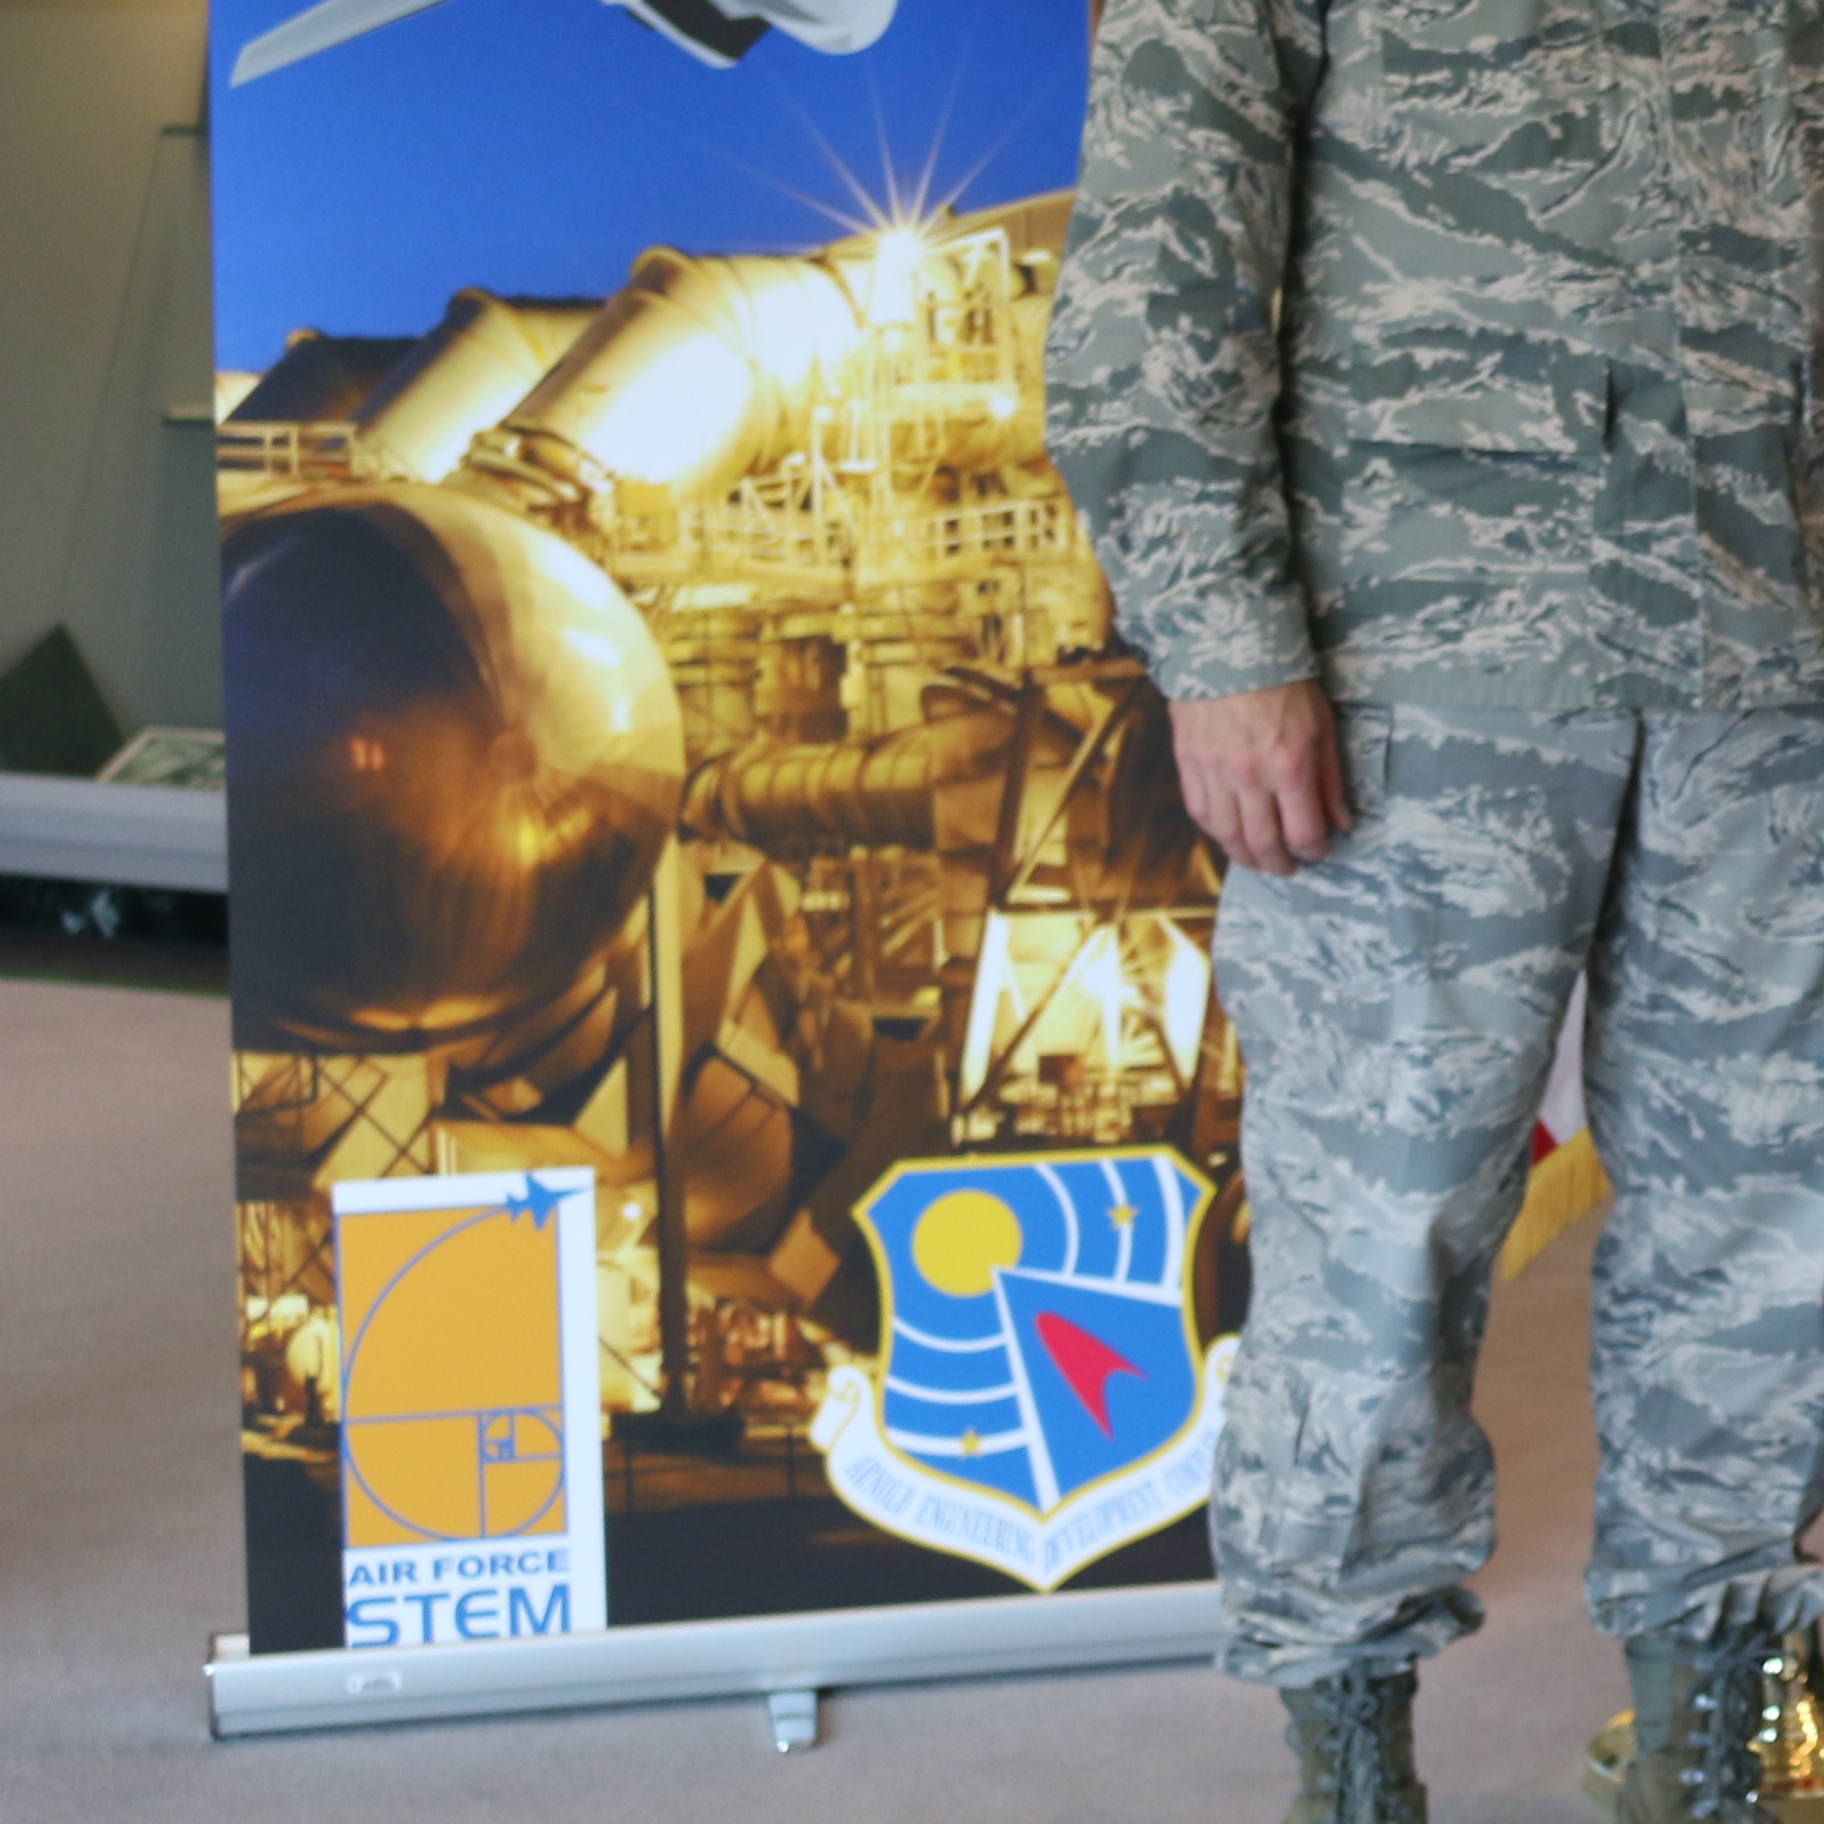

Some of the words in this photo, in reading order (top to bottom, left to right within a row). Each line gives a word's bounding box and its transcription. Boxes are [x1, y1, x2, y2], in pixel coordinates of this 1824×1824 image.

[349, 1559, 418, 1587] AIR
[432, 1549, 571, 1581] FORCE
[347, 1582, 573, 1650] STEM
